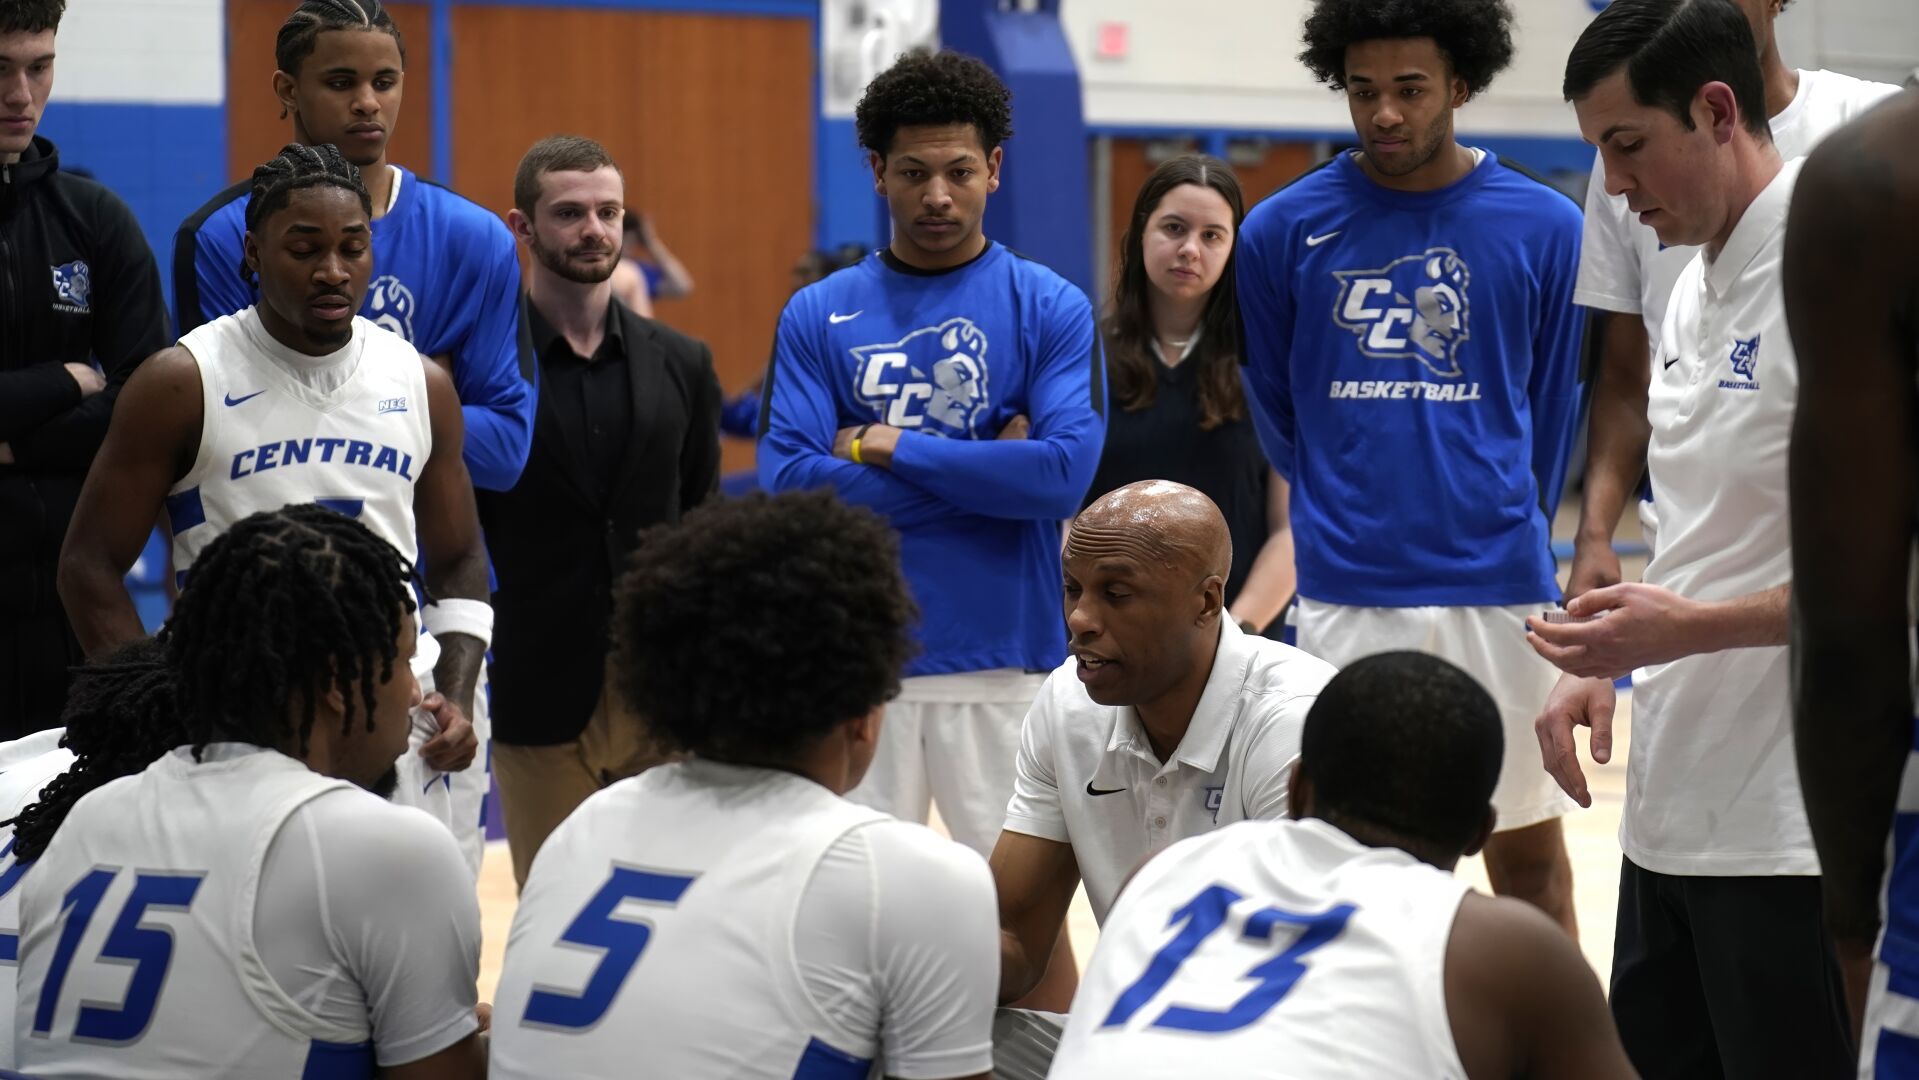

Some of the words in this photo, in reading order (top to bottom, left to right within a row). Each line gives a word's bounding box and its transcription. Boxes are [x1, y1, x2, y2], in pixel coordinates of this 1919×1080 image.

[378, 396, 407, 411] NEC
[1329, 381, 1481, 401] BASKETBALL
[230, 437, 413, 482] CENTRAL
[30, 863, 208, 1047] 15
[519, 858, 704, 1035] 5
[1095, 880, 1362, 1034] 13
